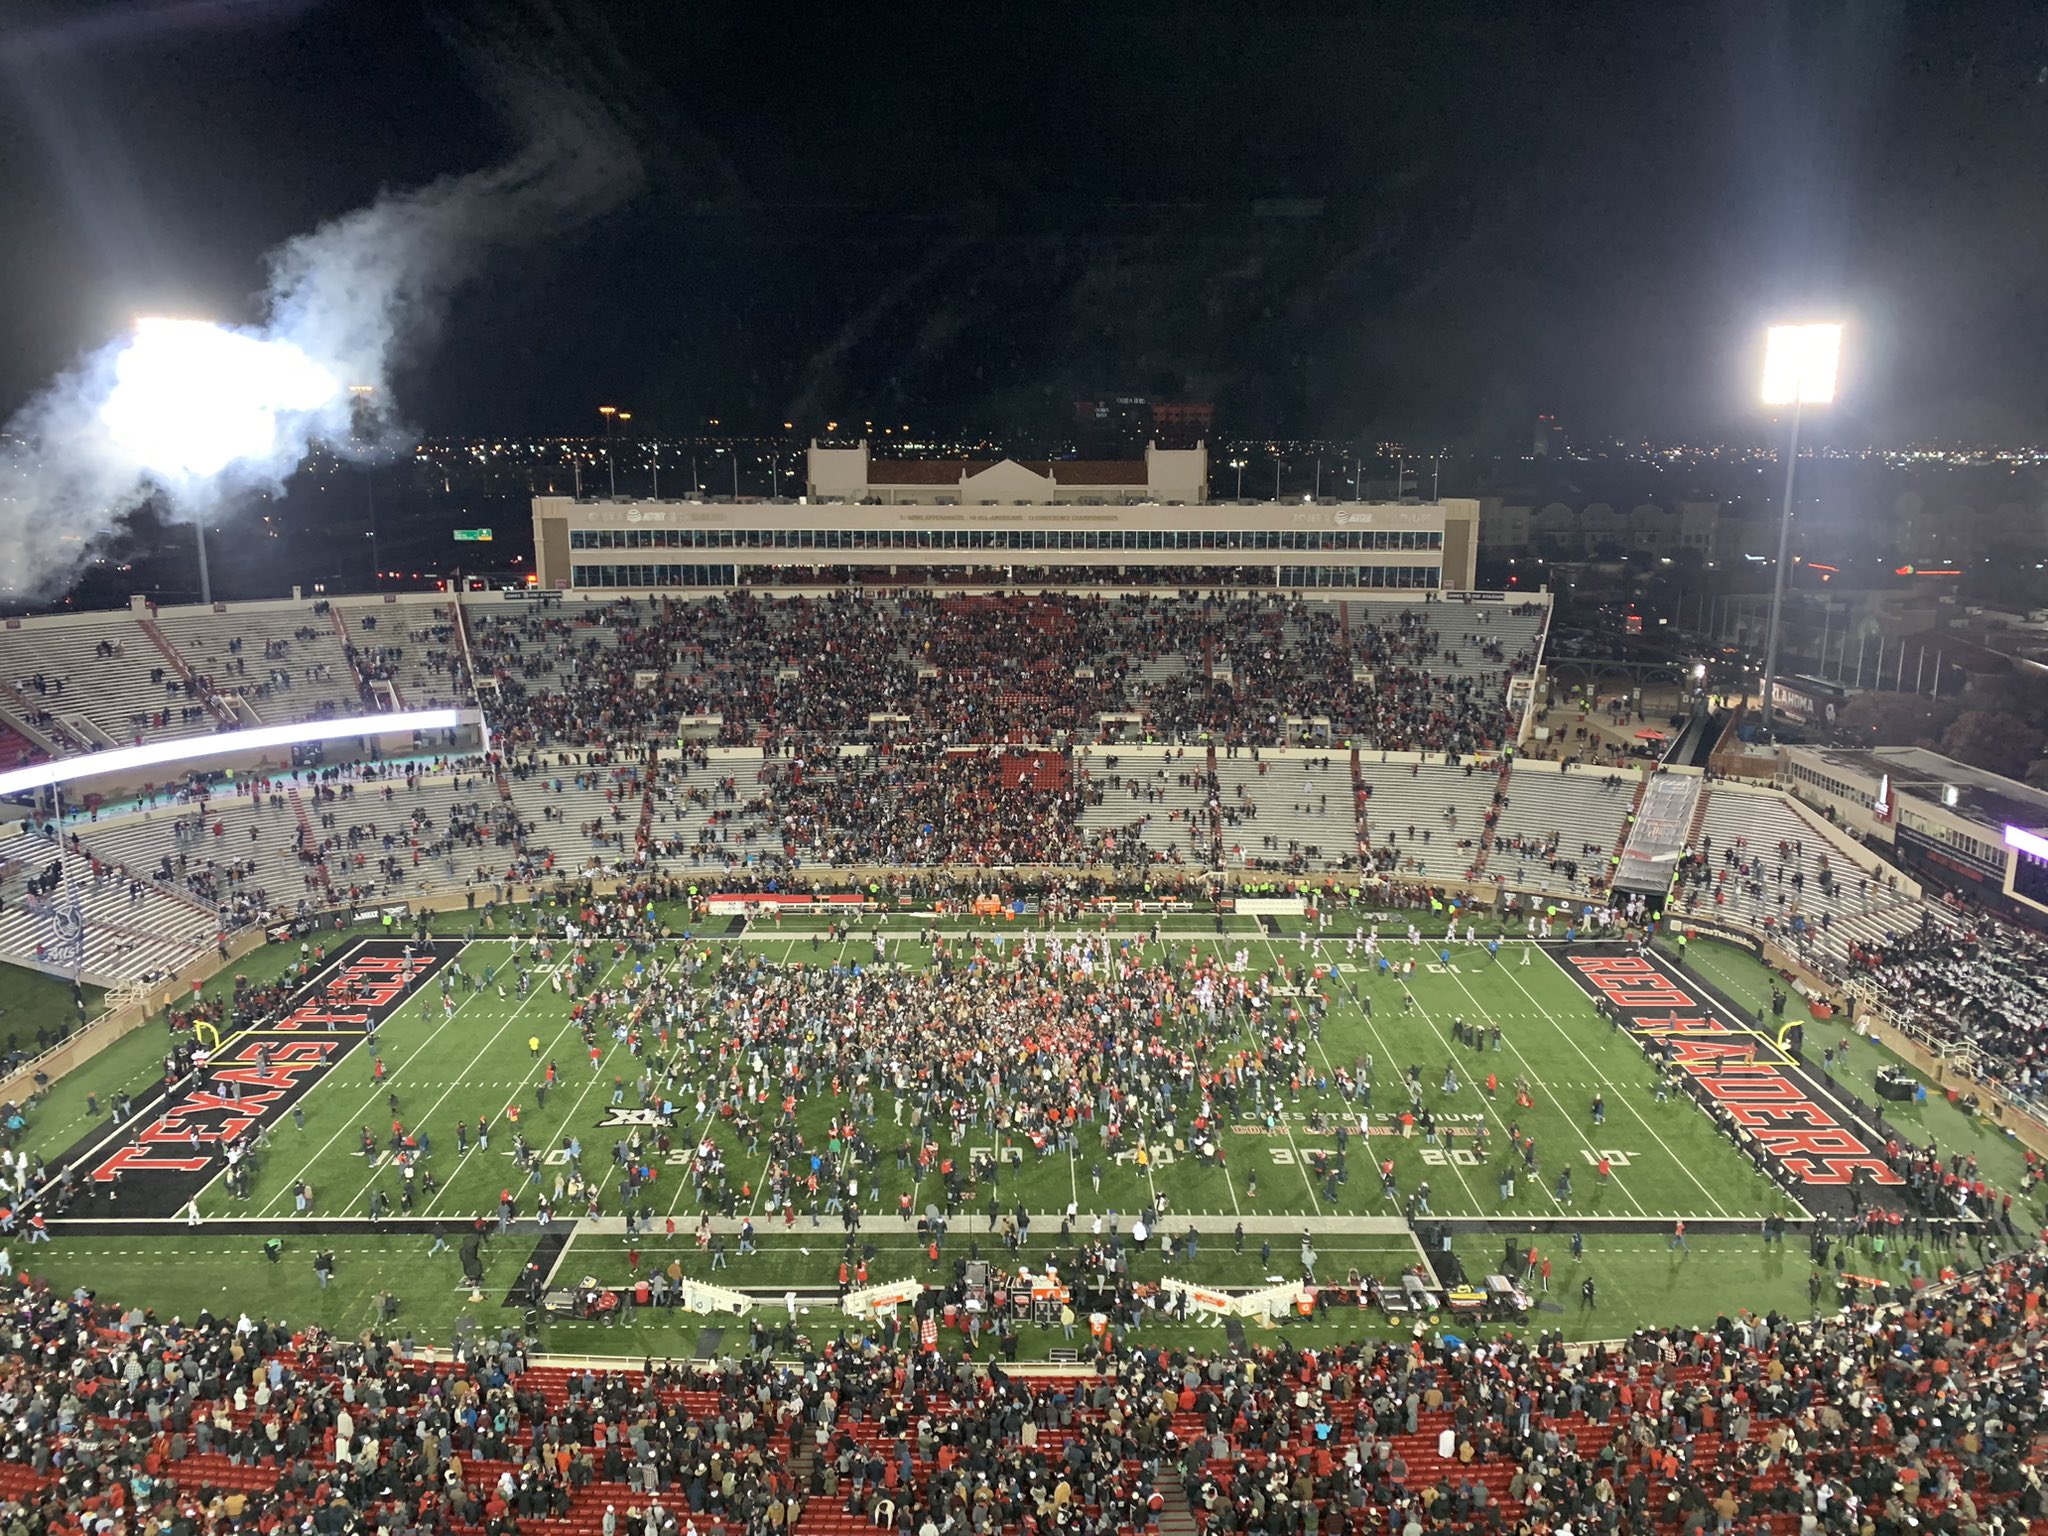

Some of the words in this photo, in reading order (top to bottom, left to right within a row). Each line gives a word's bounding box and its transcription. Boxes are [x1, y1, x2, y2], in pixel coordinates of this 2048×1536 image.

[1567, 956, 1697, 1007] RED
[83, 1041, 338, 1182] TEXAS
[1632, 1017, 1906, 1185] RAIDERS
[1580, 1150, 1631, 1166] 10
